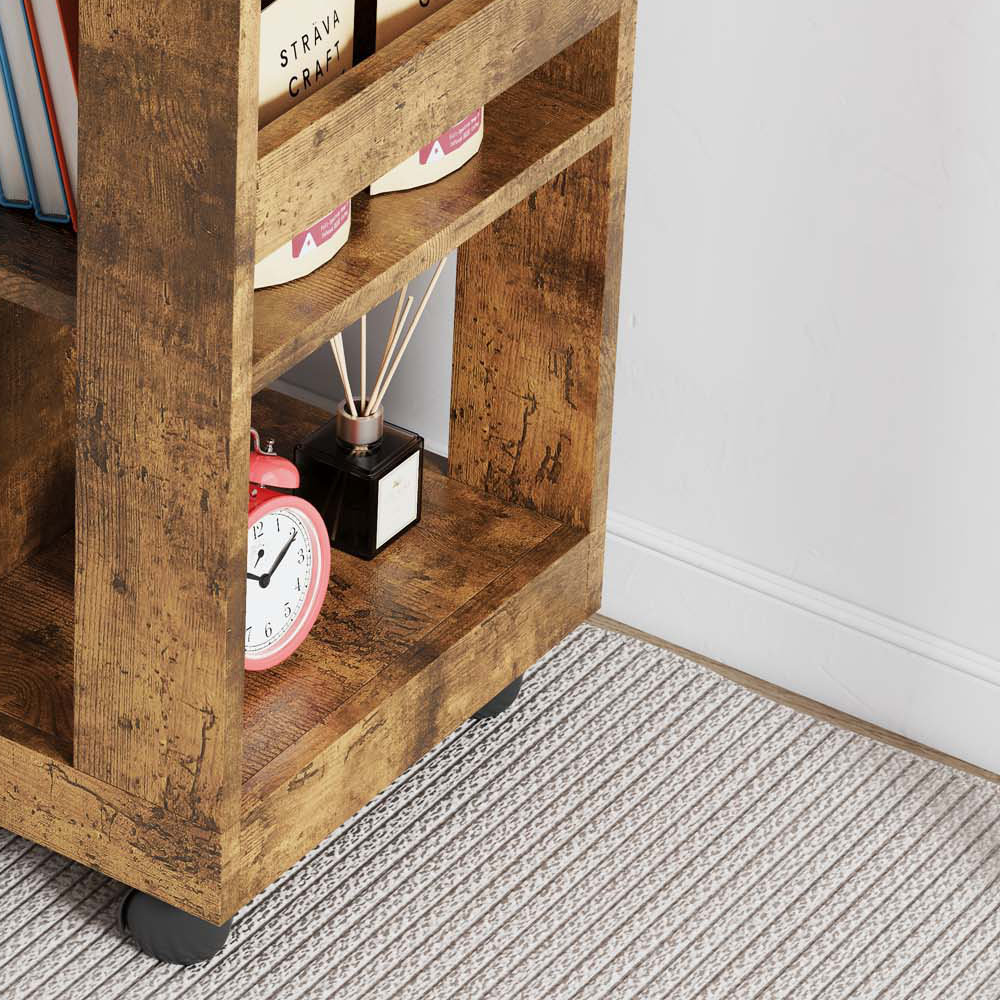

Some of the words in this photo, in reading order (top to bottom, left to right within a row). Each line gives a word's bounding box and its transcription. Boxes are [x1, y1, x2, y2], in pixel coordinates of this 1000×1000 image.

[280, 9, 340, 68] STRÄVA
[288, 40, 340, 98] CRAFT
[253, 521, 264, 540] 12
[297, 548, 305, 565] 3
[284, 602, 292, 618] 5
[264, 622, 273, 639] 6
